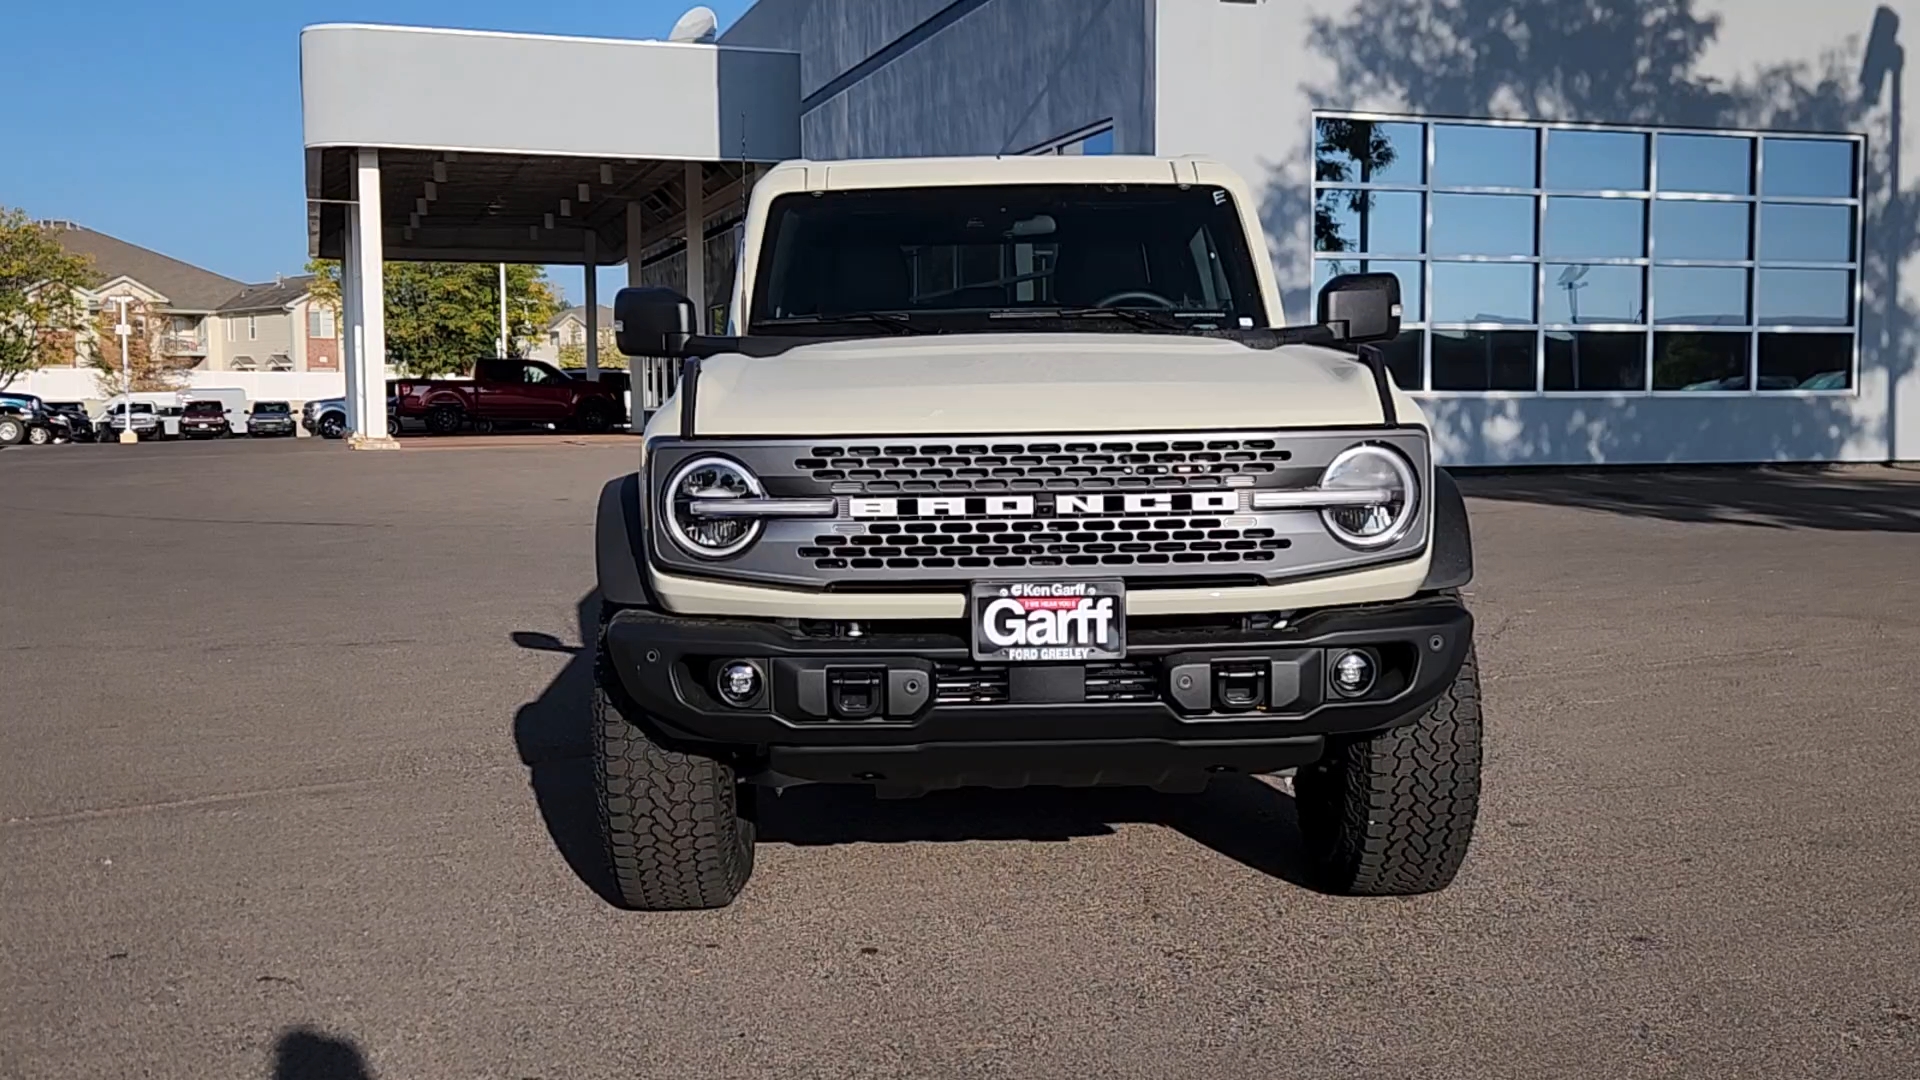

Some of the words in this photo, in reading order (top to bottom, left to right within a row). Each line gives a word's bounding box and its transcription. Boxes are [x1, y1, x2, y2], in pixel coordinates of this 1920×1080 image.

[850, 491, 1239, 517] BRONCO
[1023, 583, 1050, 597] Ken
[1051, 583, 1086, 597] Garff
[983, 597, 1113, 646] Garff
[1009, 648, 1038, 660] FORD
[1040, 648, 1090, 660] GREELEY
